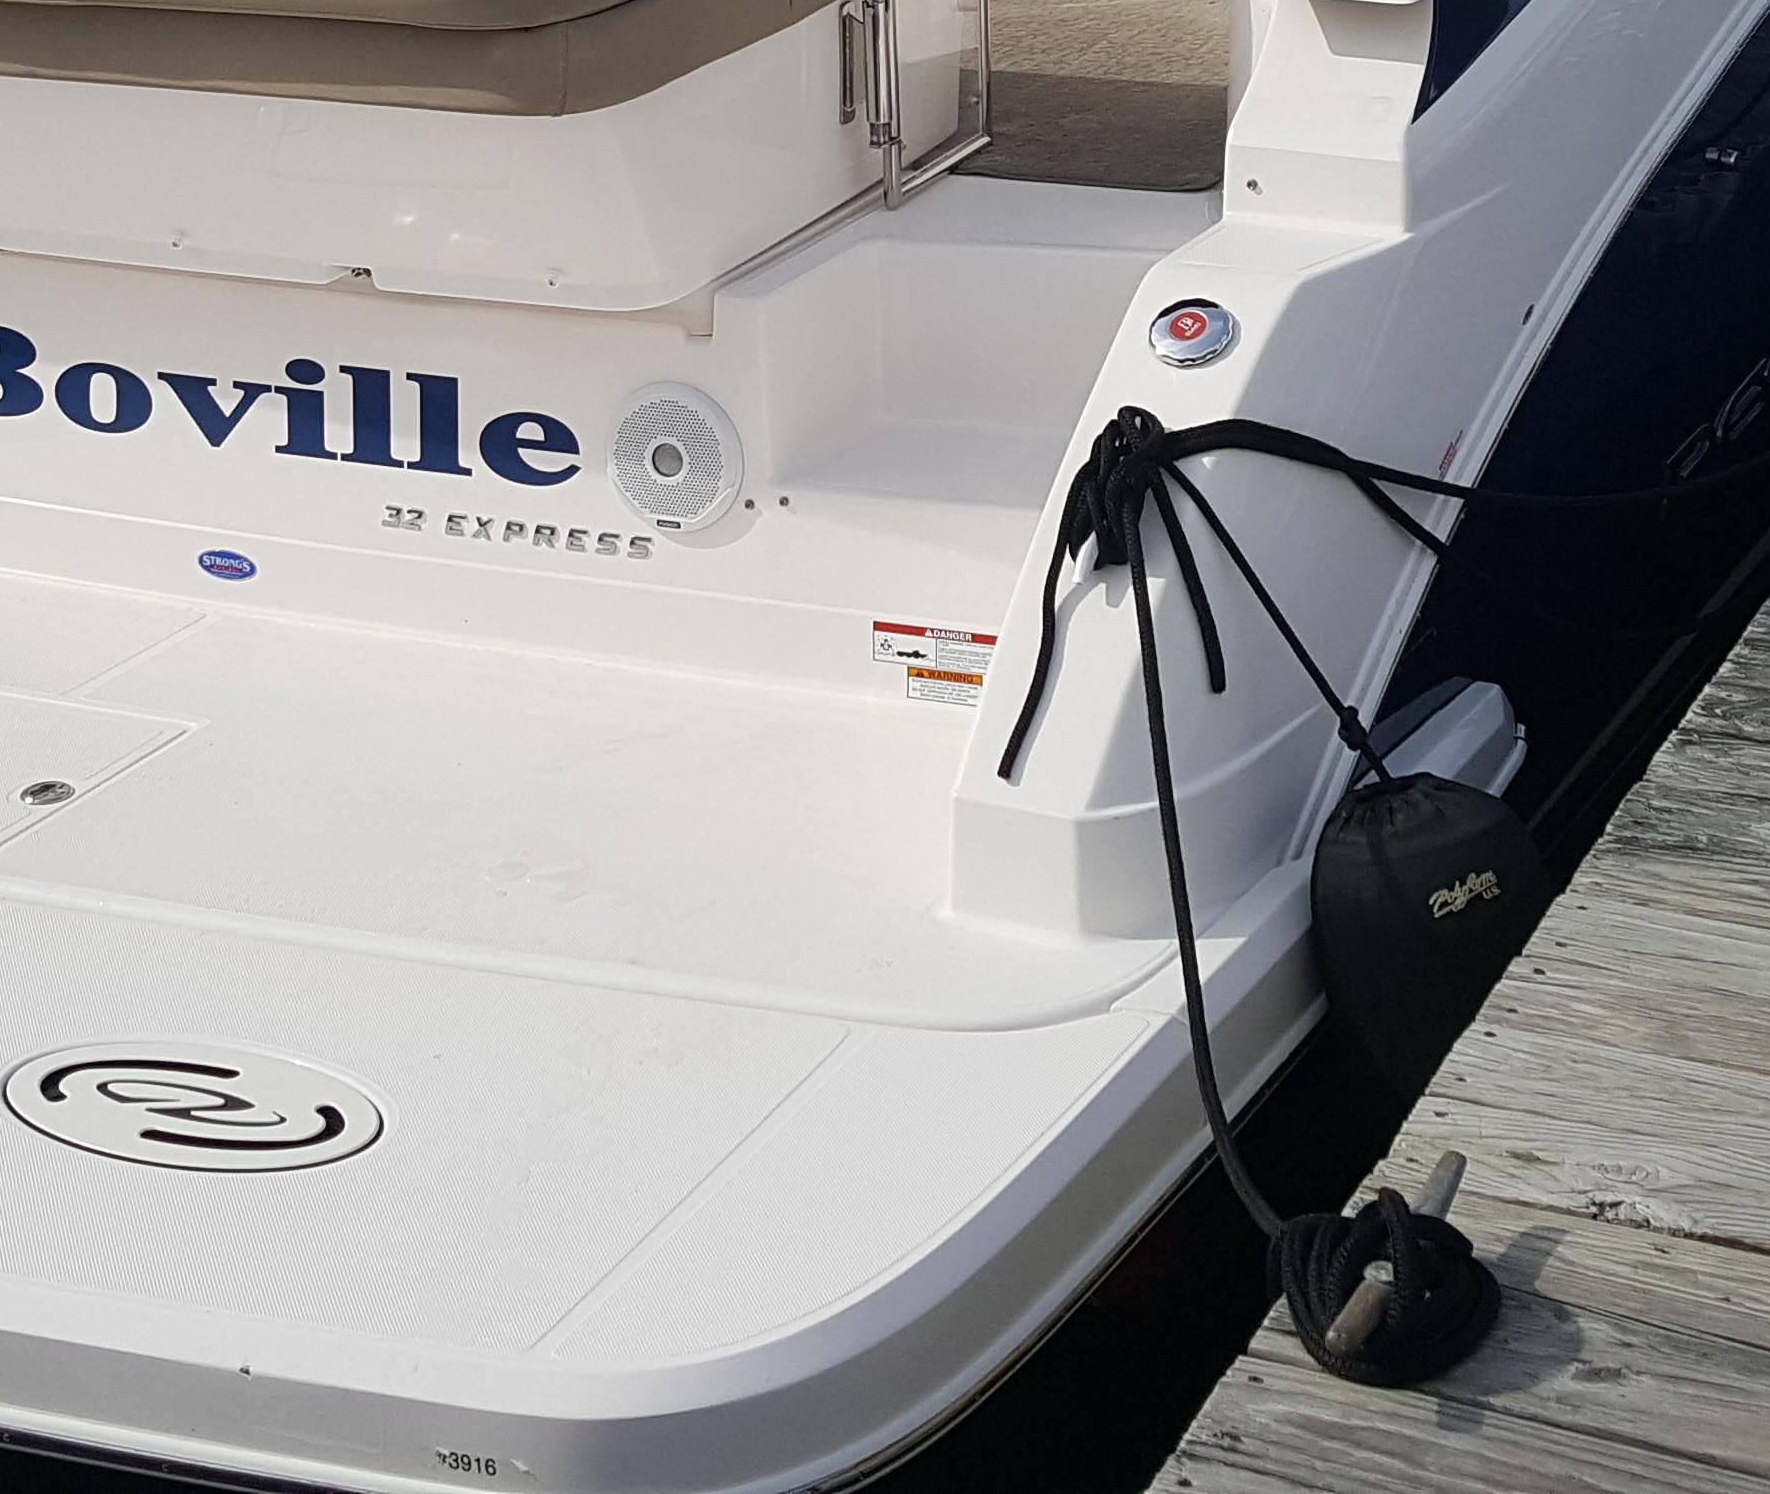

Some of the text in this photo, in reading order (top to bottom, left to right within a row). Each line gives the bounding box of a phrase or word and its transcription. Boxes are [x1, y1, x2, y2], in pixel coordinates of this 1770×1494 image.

[380, 504, 655, 560] 32 EXPRESS
[933, 629, 973, 642] DANGER
[928, 669, 974, 683] WARNING
